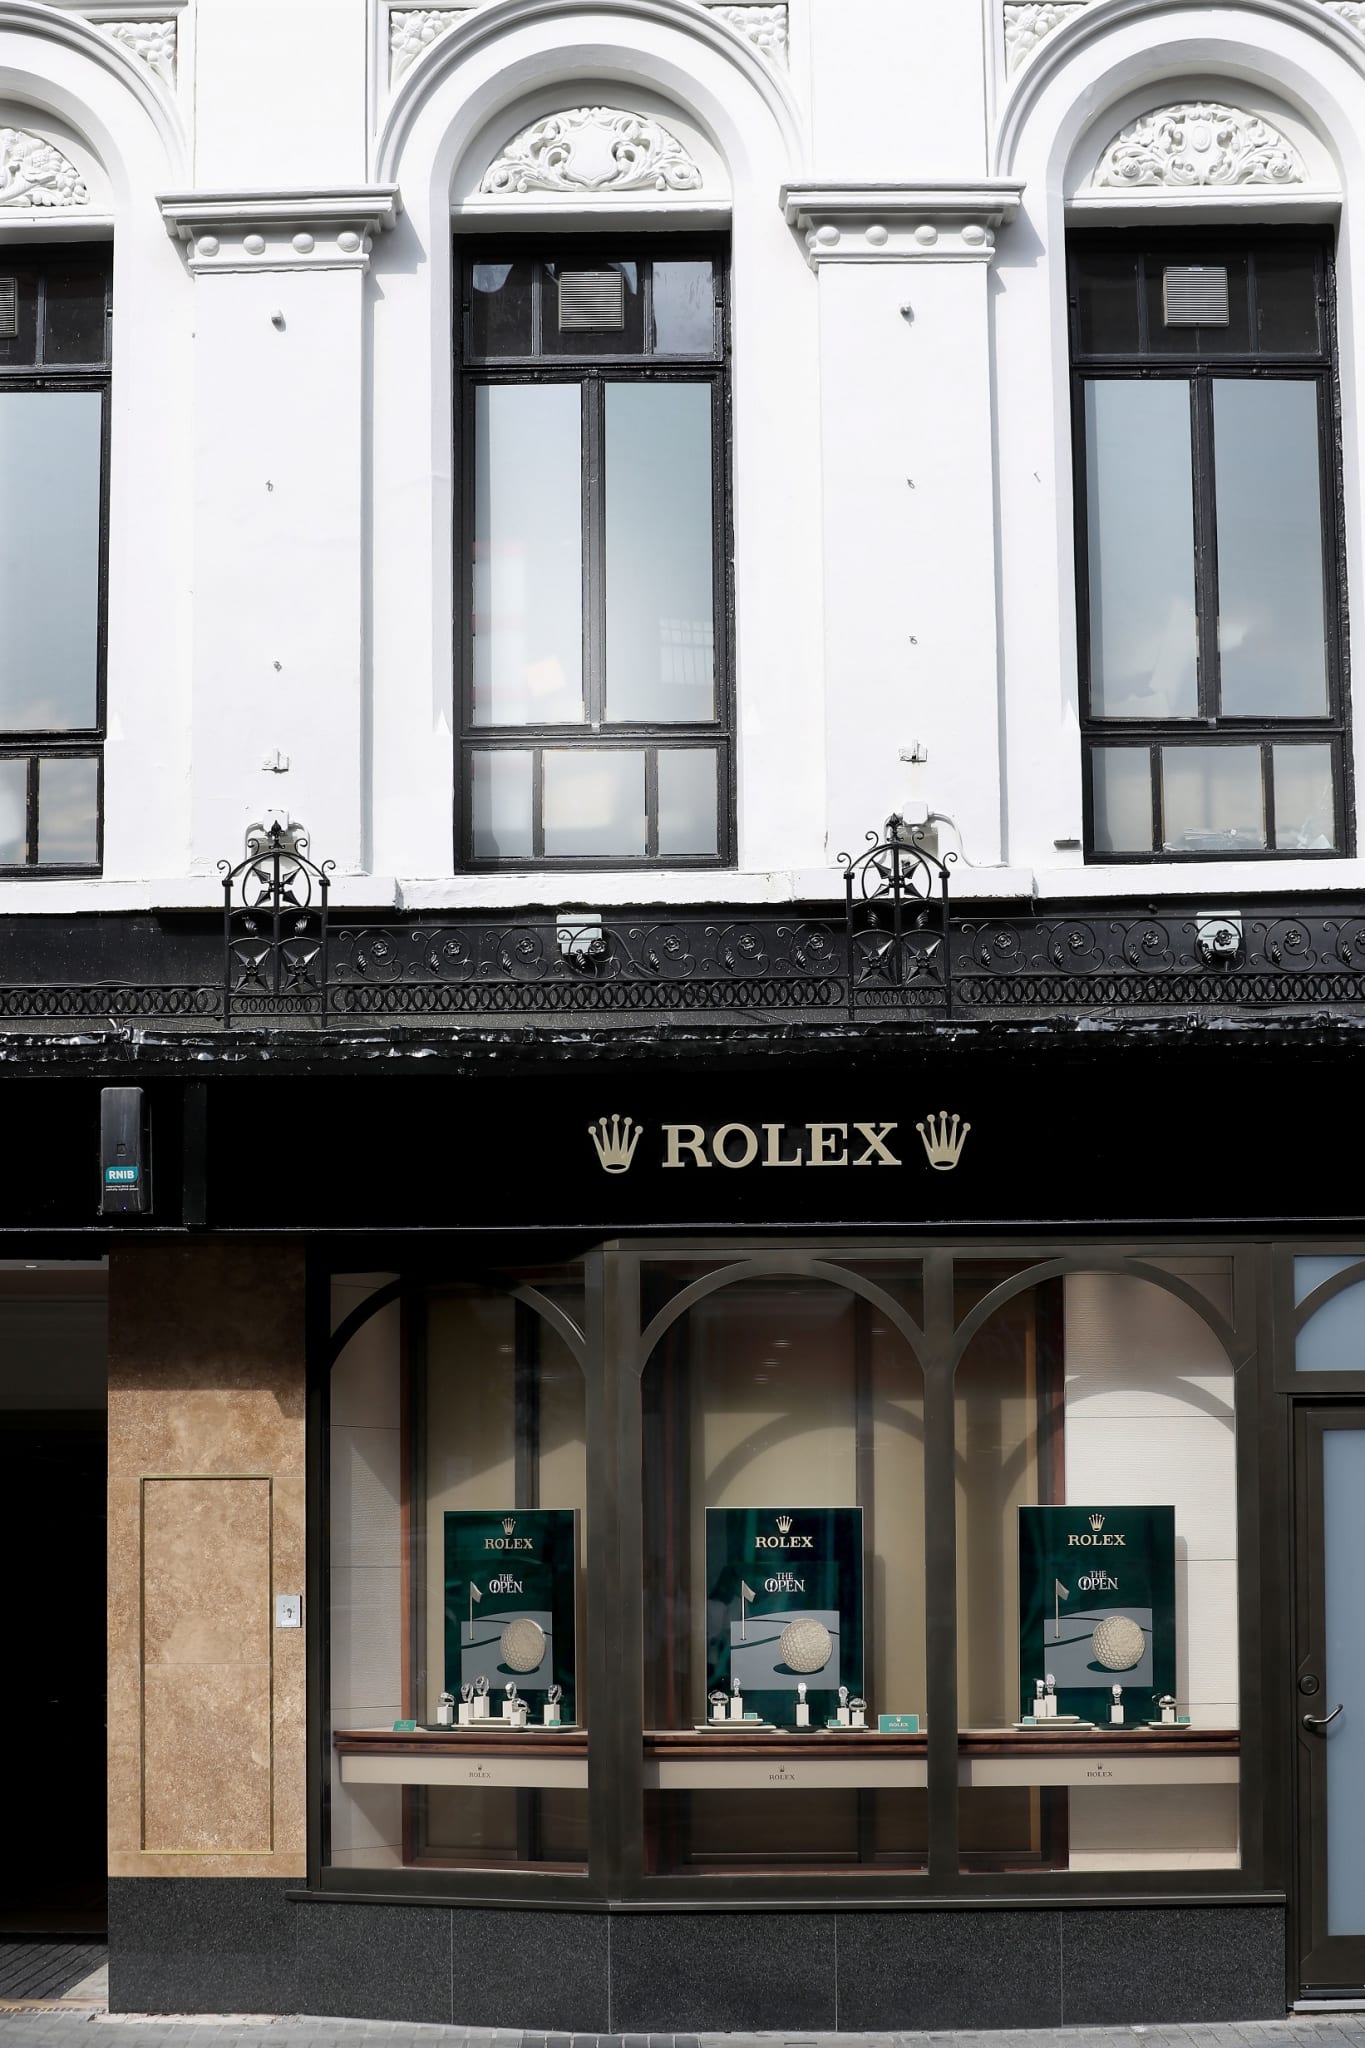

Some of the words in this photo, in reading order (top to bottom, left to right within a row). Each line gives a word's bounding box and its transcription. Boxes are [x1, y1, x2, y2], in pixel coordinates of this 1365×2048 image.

[661, 1123, 902, 1168] ROLEX
[108, 1170, 135, 1180] RNIB
[484, 1538, 533, 1550] ROLEX
[755, 1536, 814, 1548] ROLEX
[1067, 1534, 1126, 1546] ROLEX
[499, 1573, 514, 1582] THE
[776, 1572, 794, 1580] THE
[1089, 1570, 1107, 1579] THE
[489, 1579, 524, 1594] OPEN
[764, 1578, 806, 1593] OPEN
[1077, 1576, 1119, 1591] OPEN
